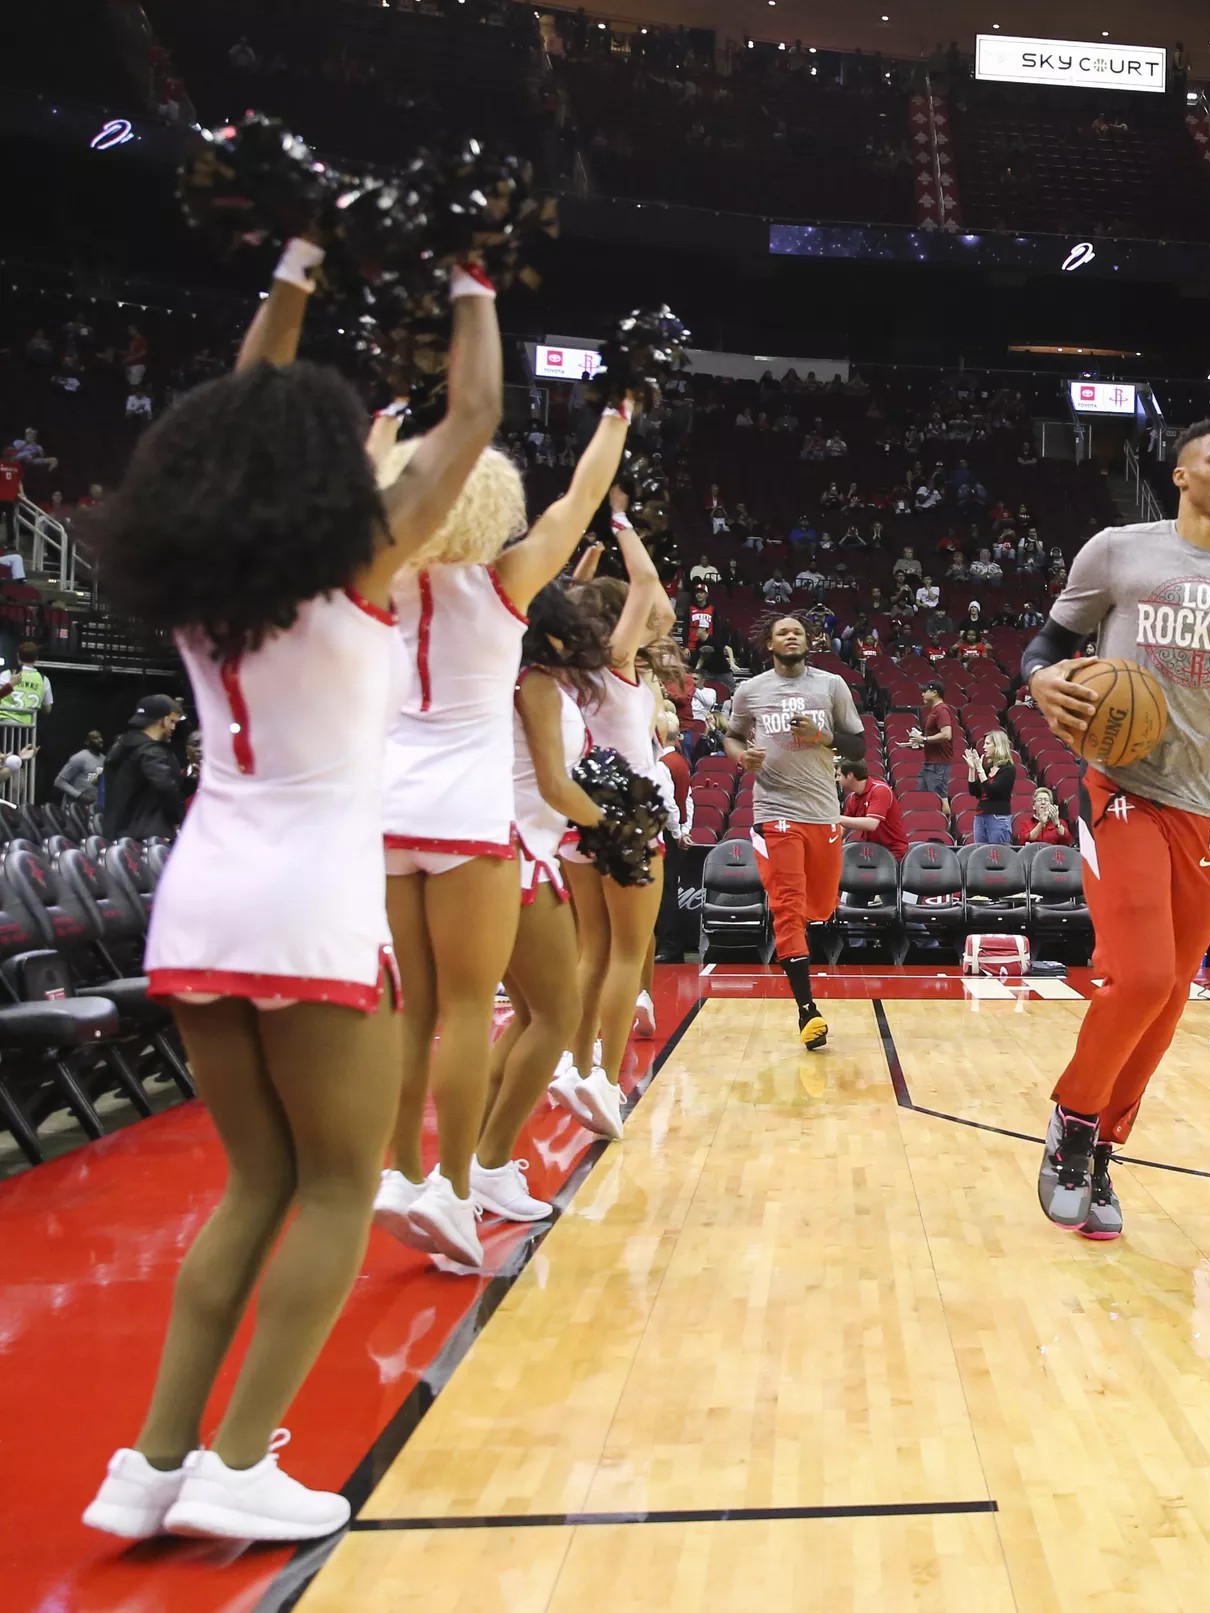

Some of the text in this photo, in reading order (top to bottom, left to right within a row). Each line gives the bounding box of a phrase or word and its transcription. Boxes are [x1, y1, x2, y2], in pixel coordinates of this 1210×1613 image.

[1022, 53, 1072, 70] SKY
[781, 697, 805, 712] LOS
[761, 710, 825, 734] ROCTS
